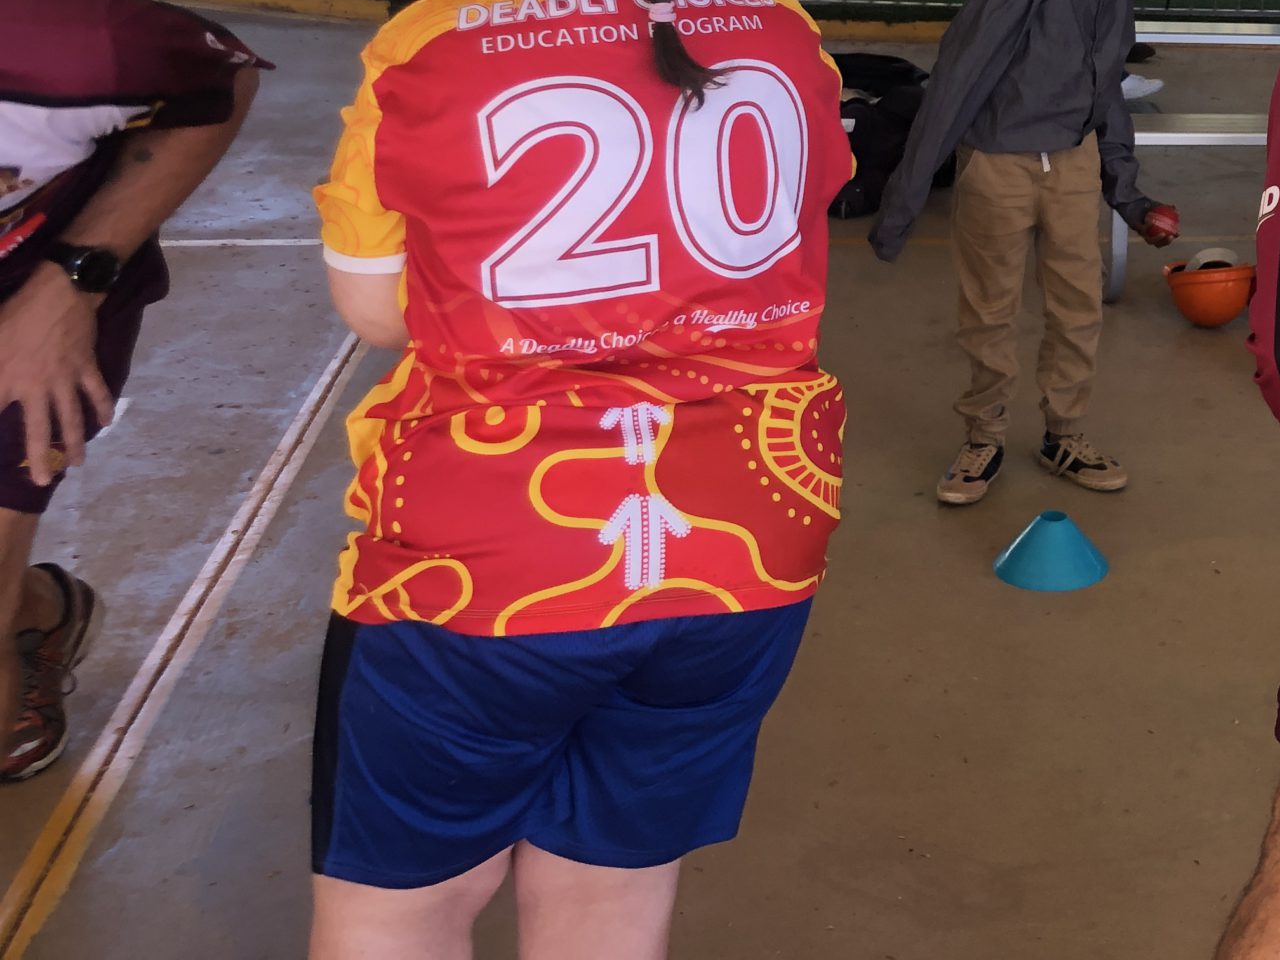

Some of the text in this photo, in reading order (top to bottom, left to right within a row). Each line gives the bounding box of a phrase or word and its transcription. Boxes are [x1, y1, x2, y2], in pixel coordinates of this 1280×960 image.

[481, 23, 638, 55] EDUCATION
[477, 59, 808, 309] 20
[499, 337, 515, 354] A
[519, 336, 598, 355] Deadly
[673, 314, 687, 325] a
[691, 309, 758, 331] Healthy
[761, 299, 811, 322] Choice
